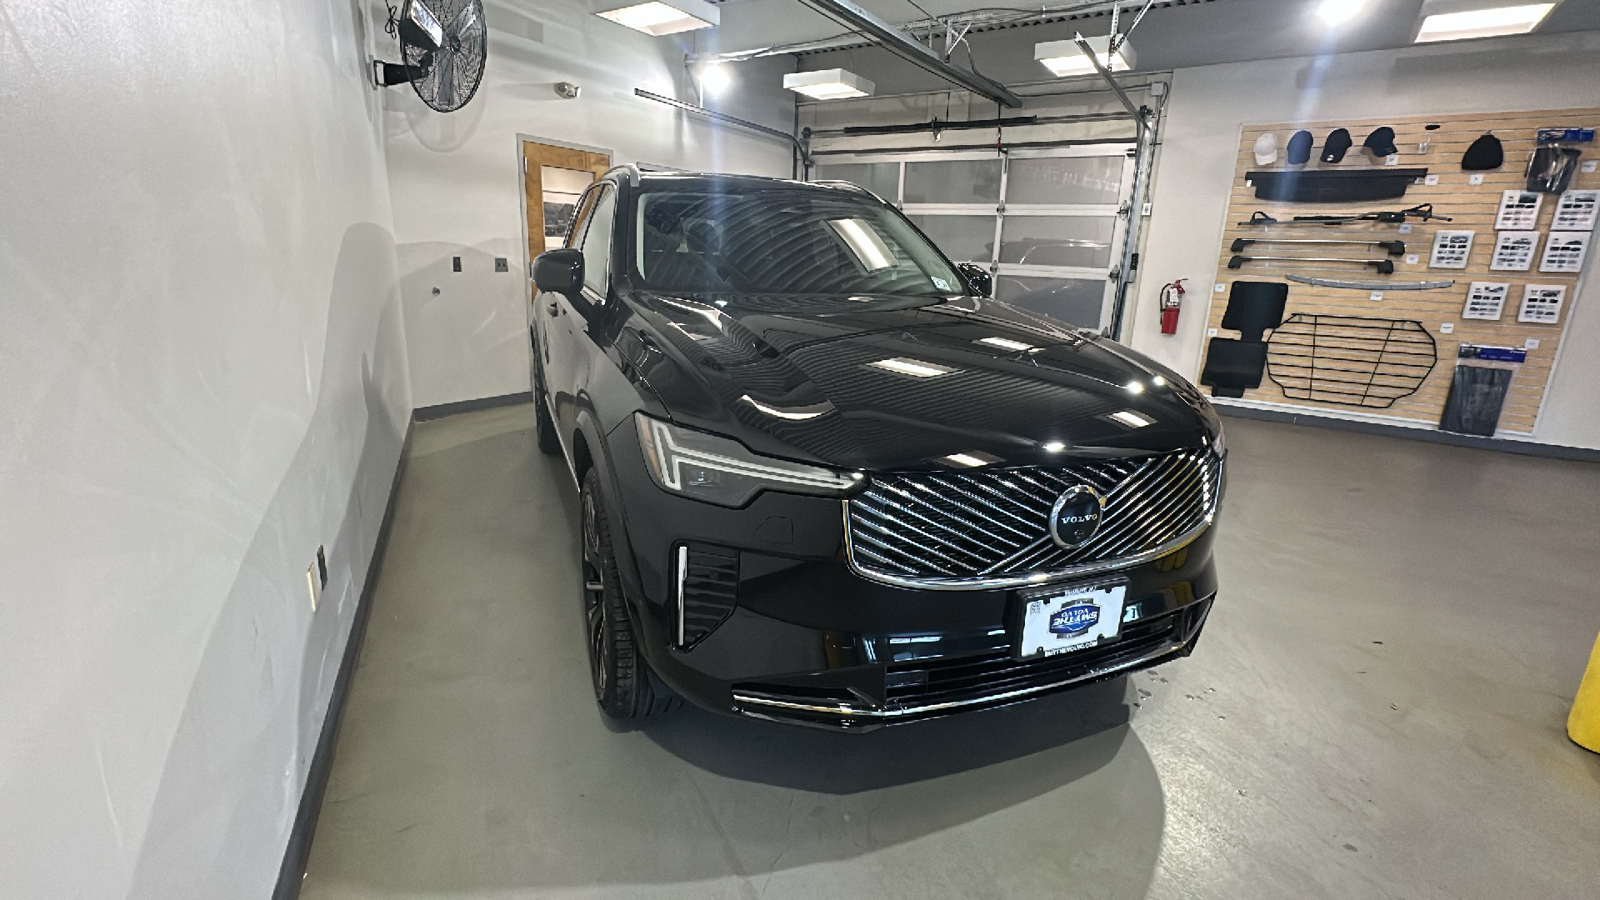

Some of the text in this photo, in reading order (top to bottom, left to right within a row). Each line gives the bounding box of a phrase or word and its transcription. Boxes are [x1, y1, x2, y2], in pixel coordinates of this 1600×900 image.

[1061, 513, 1098, 524] VOLVO
[1052, 611, 1098, 626] SMYTHE
[1061, 608, 1089, 618] VOLVO
